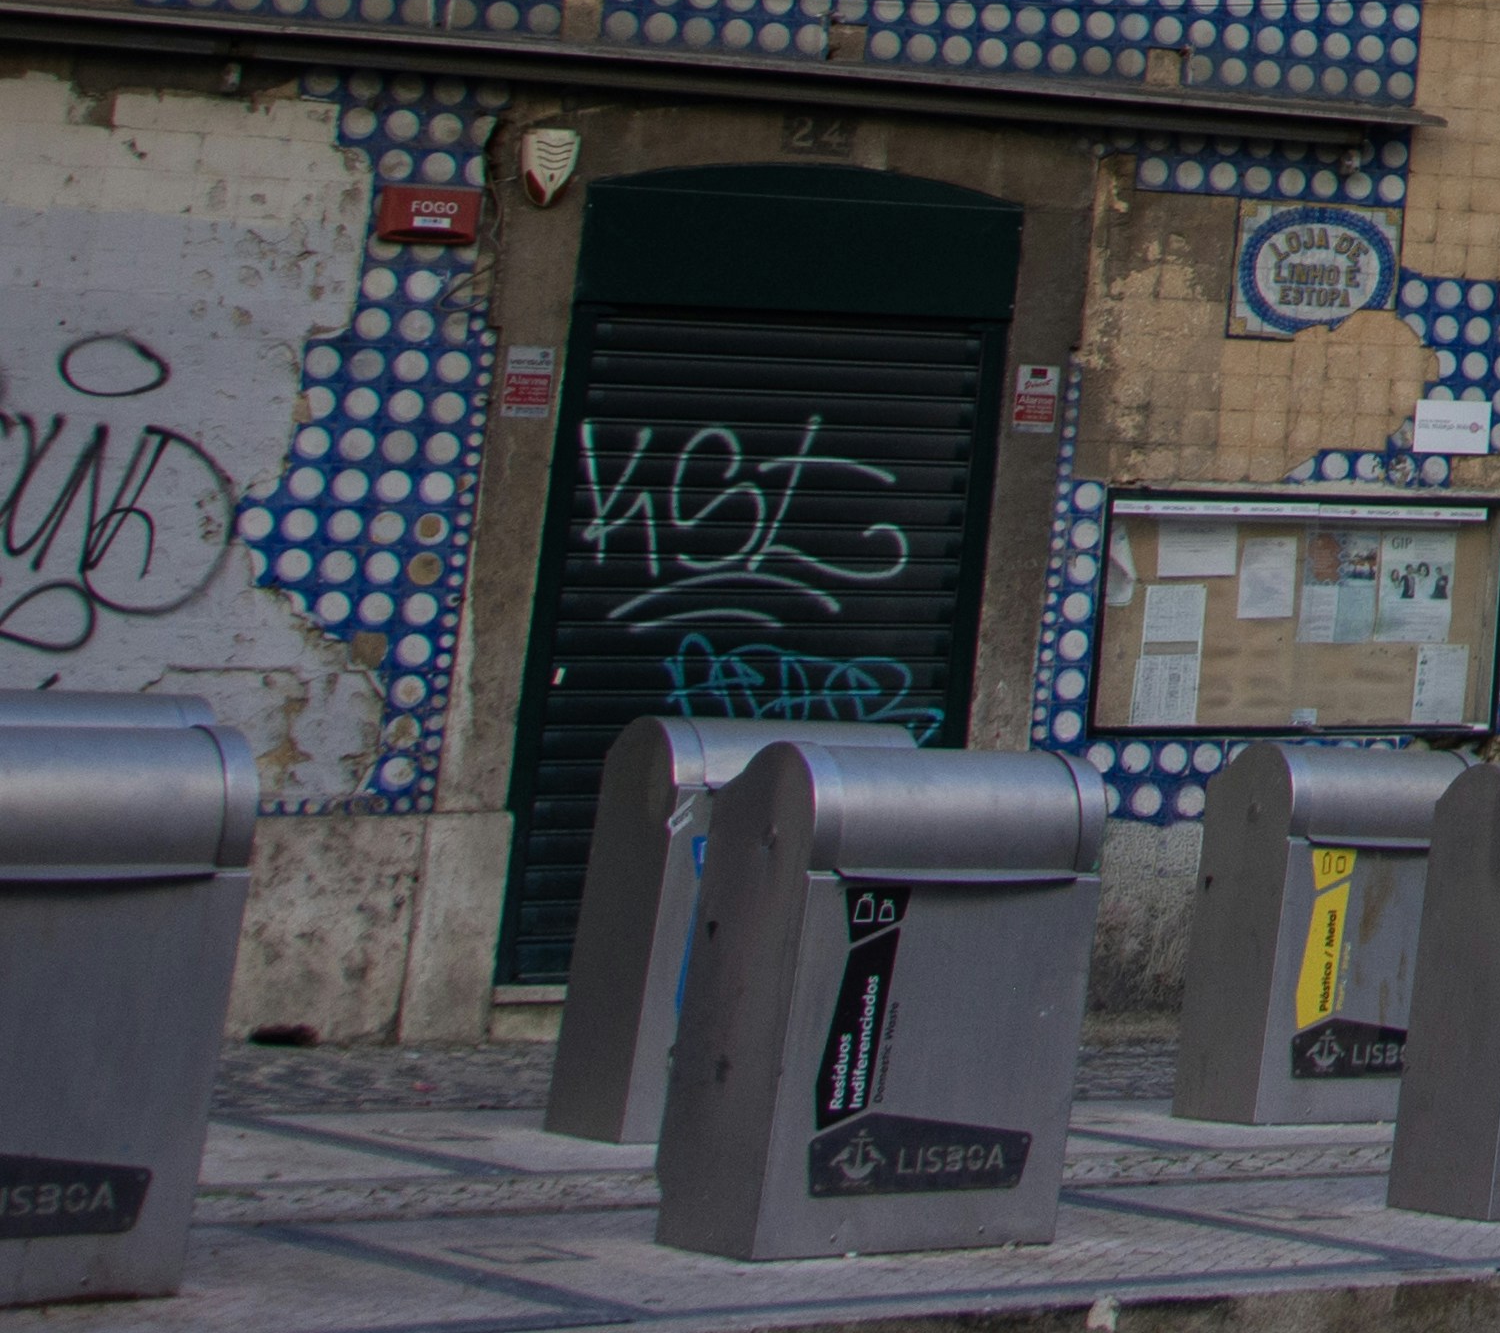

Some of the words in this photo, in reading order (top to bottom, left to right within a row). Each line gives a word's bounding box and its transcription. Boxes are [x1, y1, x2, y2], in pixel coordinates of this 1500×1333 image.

[411, 200, 458, 214] FOGO
[1268, 227, 1330, 261] LOJA
[1334, 232, 1370, 264] DE
[1273, 261, 1341, 287] LINHO
[1344, 265, 1361, 288] E
[1278, 285, 1351, 307] ESTOPA
[508, 375, 549, 386] Alarme
[1392, 536, 1413, 549] GIP
[1325, 910, 1338, 948] Metal
[1319, 962, 1334, 1013] Plástico
[884, 1001, 899, 1041] Waste
[848, 974, 880, 1110] Indiferenciados
[896, 1145, 1005, 1175] LISBOA
